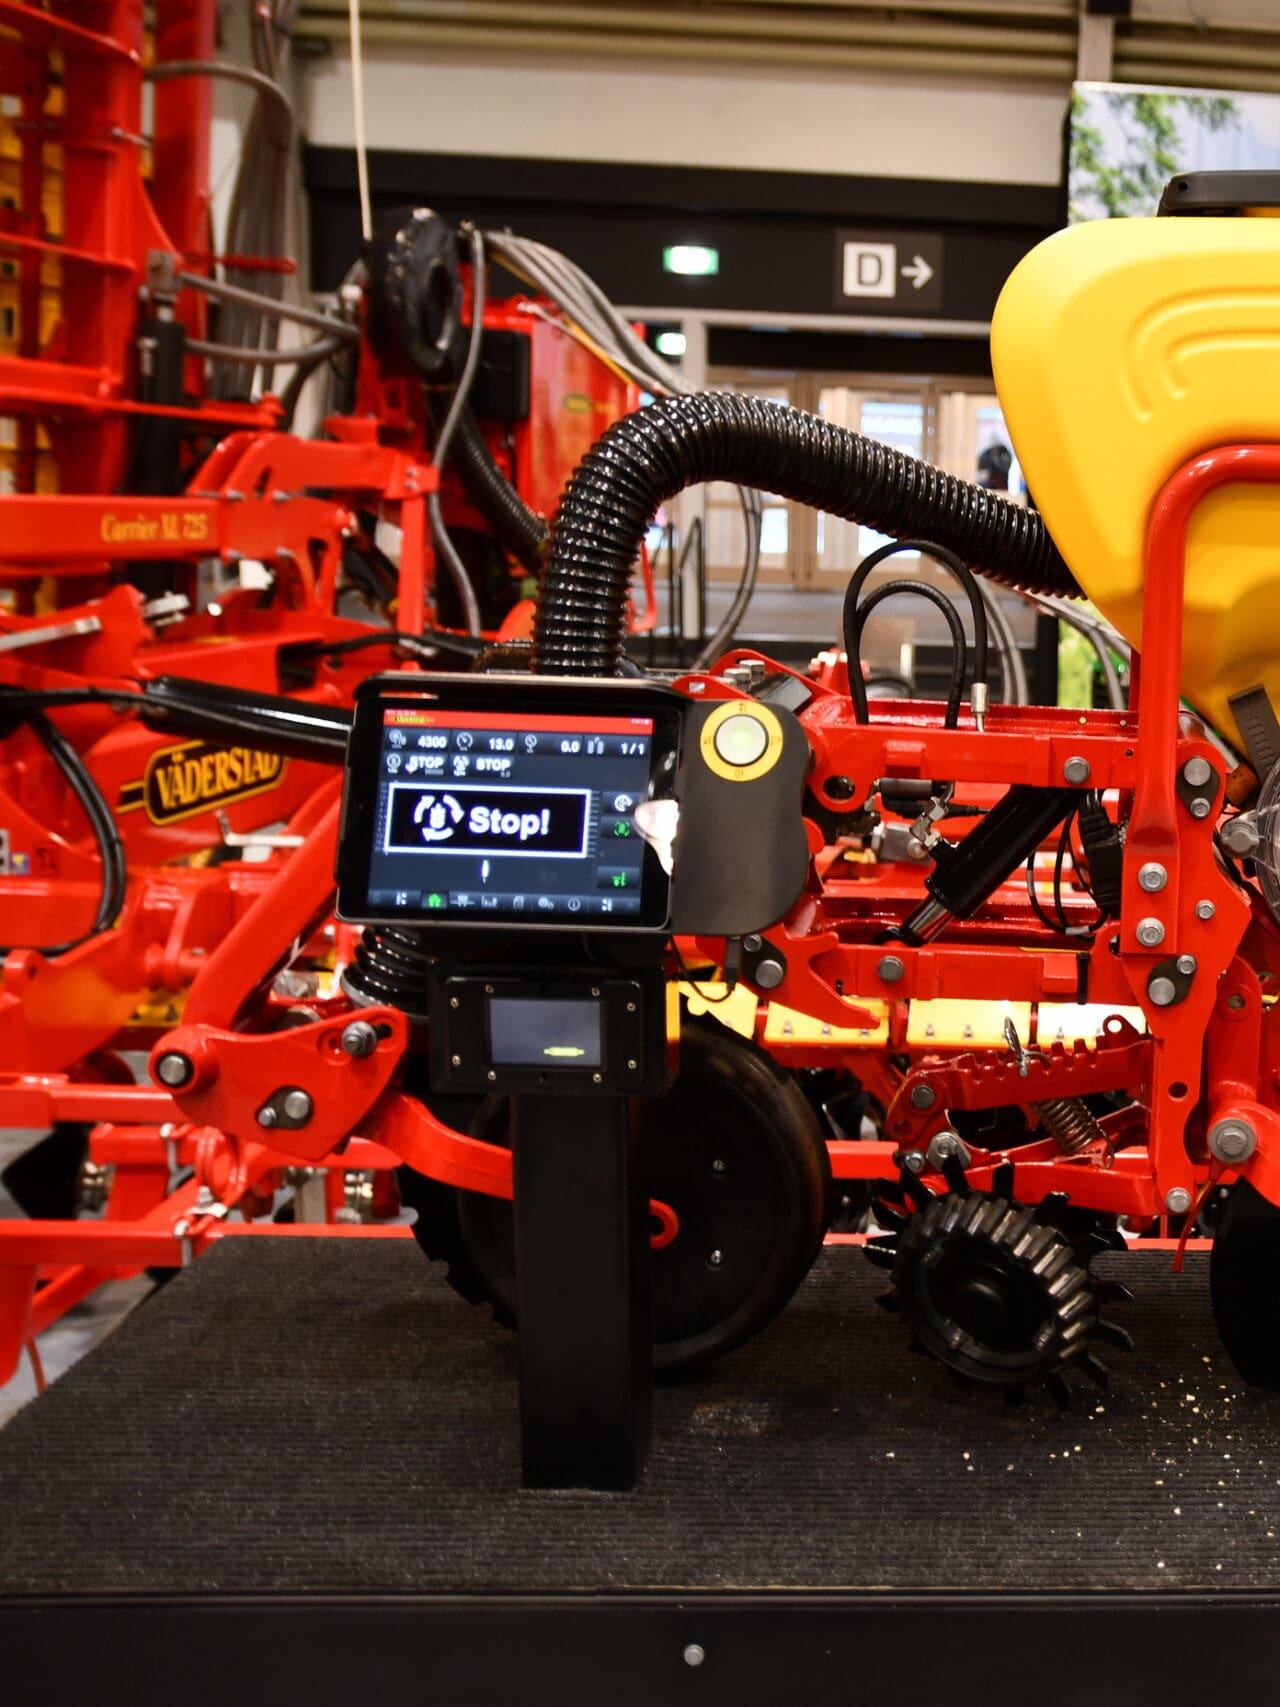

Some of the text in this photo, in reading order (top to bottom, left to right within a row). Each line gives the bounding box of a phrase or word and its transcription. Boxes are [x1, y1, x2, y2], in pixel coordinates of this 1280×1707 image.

[857, 251, 883, 287] D
[101, 513, 208, 542] Carrier XL 725
[417, 734, 447, 748] 4300
[489, 737, 514, 751] 13.0
[560, 739, 581, 753] 0.0
[408, 754, 445, 769] STOP
[476, 757, 512, 771] STOP
[469, 806, 551, 841] Stop!
